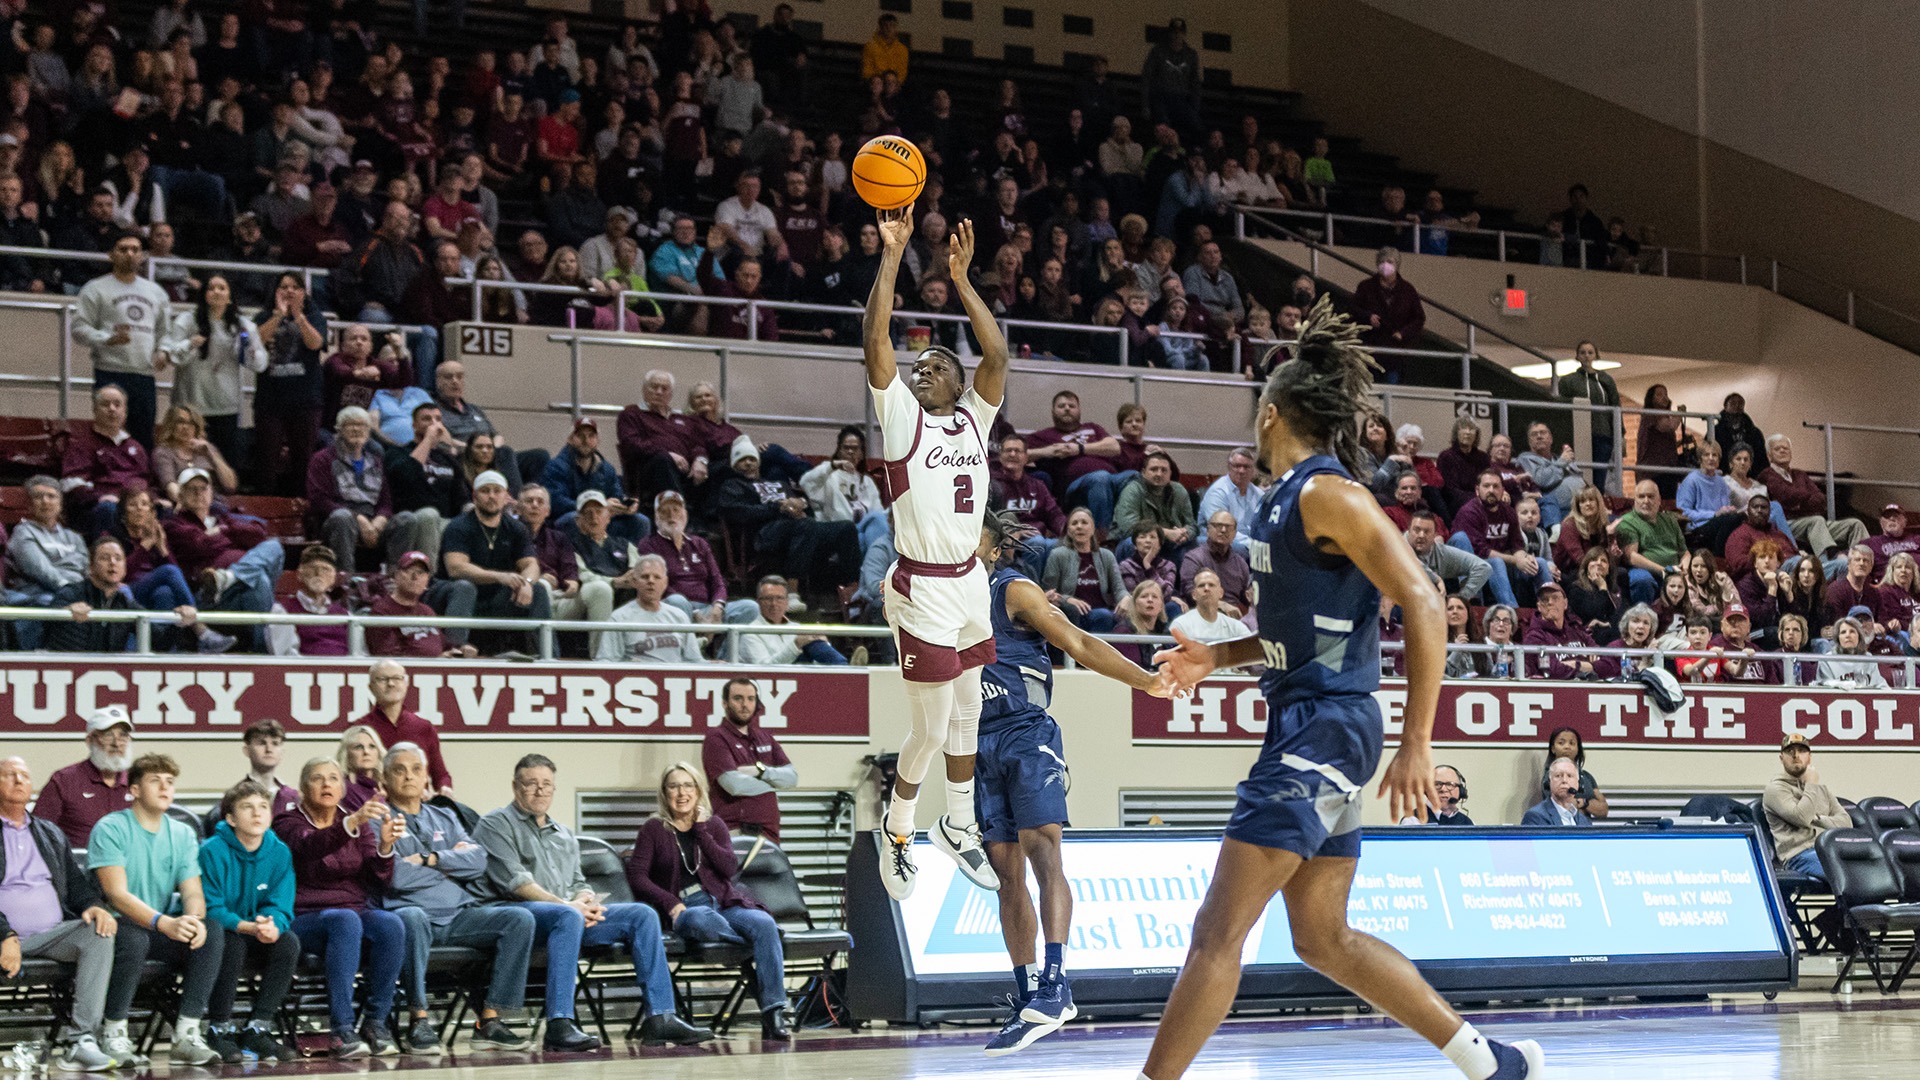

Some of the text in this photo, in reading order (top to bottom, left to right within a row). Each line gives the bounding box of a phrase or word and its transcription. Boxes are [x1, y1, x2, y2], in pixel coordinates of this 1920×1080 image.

[463, 328, 511, 354] 215
[953, 474, 975, 514] 2
[0, 670, 254, 725] UCKY
[1167, 687, 1920, 740] HOE OF THE COL
[1386, 872, 1424, 889] Street
[1482, 871, 1530, 888] Eastern
[1529, 871, 1574, 891] Bypass
[1611, 869, 1752, 886] 525 Walnut Meadow Road
[1371, 895, 1389, 911] KY
[1392, 894, 1429, 911] 40475
[1527, 893, 1546, 909] KY
[1548, 892, 1583, 908] 40475
[1680, 891, 1698, 905] KY
[1068, 913, 1193, 950] ust Ba
[1133, 967, 1177, 975] DAKTRONICS
